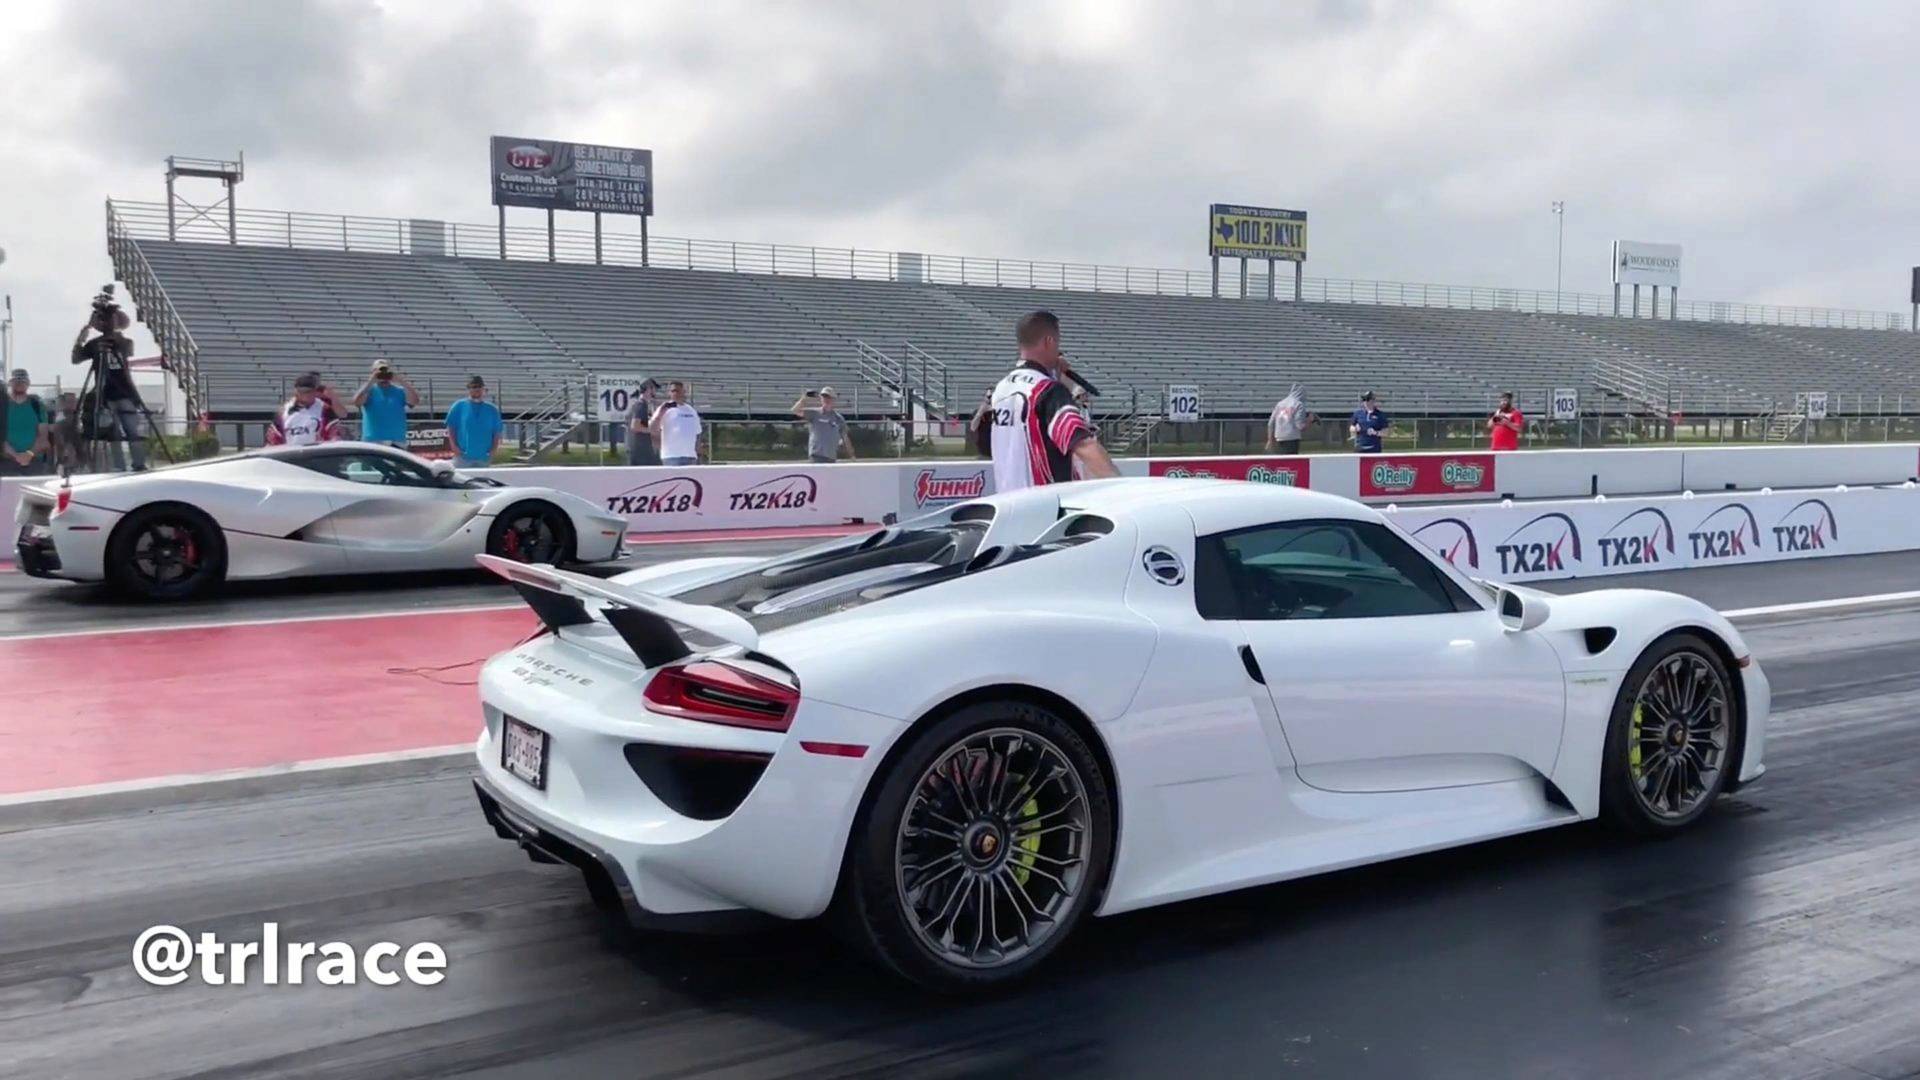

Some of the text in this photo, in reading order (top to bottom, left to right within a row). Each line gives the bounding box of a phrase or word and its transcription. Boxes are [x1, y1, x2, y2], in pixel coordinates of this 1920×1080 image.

[1234, 219, 1273, 246] 100.3
[1171, 396, 1198, 413] 102
[1555, 398, 1575, 413] 103
[607, 482, 807, 514] TX2K18 TX2K18
[1495, 532, 1566, 575] TX2K
[1598, 525, 1661, 567] TX2K
[1688, 520, 1746, 560] TX2K
[1773, 514, 1825, 552] TX2K
